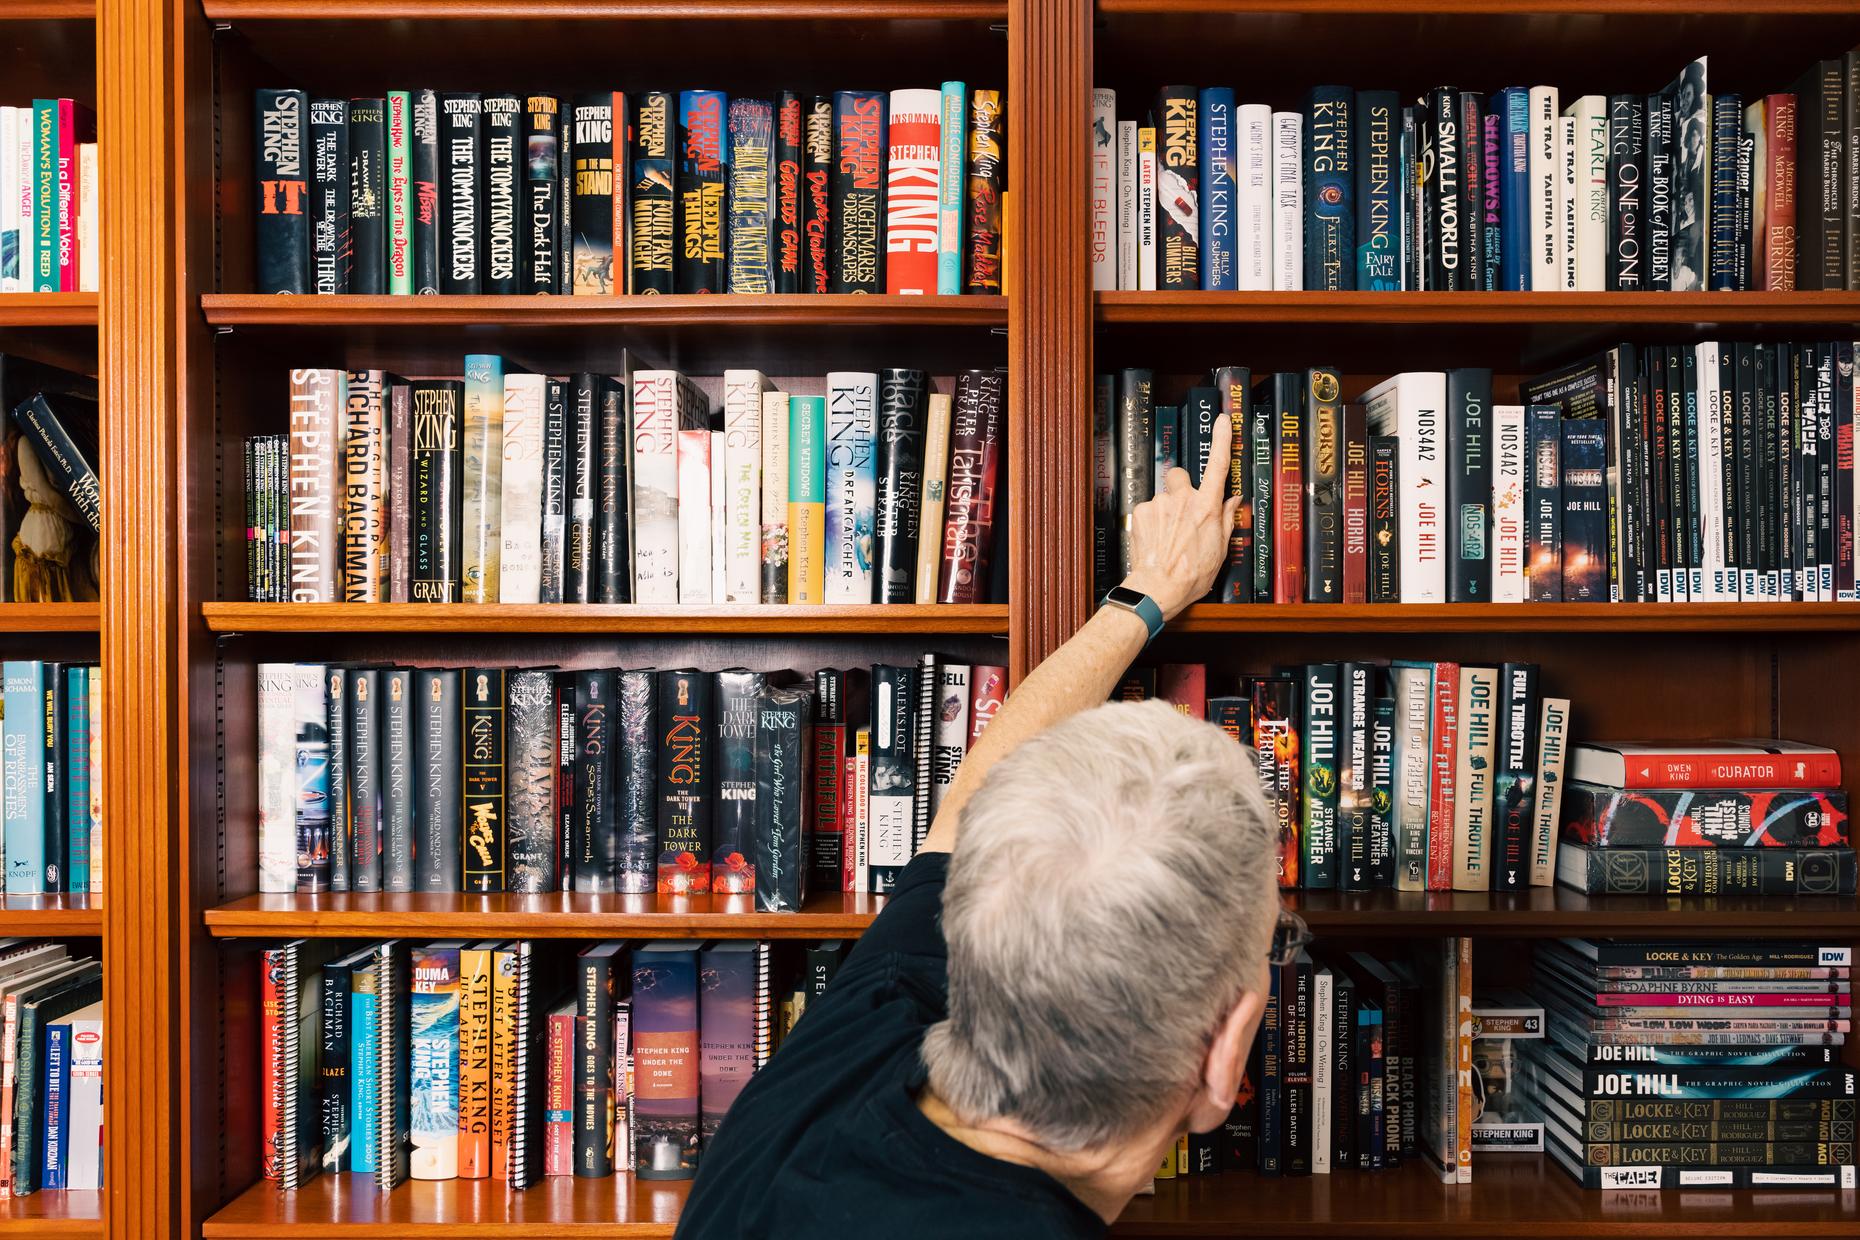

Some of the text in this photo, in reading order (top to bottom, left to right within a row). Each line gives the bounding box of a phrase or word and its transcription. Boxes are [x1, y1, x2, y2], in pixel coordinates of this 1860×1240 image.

[444, 100, 482, 115] STEPHEN
[453, 114, 473, 129] KING
[576, 107, 612, 122] STEPHEN
[891, 113, 940, 125] INSOMNIA
[1614, 102, 1629, 156] KING
[1633, 102, 1642, 156] TABITHA
[264, 111, 283, 163] KING
[275, 96, 301, 176] STEPHEN
[576, 122, 612, 144] KING
[841, 116, 857, 174] KING
[854, 98, 880, 190] STEPHEN
[890, 147, 939, 162] STEPHEN
[1166, 99, 1186, 168] KING
[1186, 99, 1197, 167] STEPHEN
[40, 109, 53, 277] WOMAN'S EVOLUTION REED
[260, 181, 308, 215] IT
[576, 172, 613, 195] STAND
[1123, 126, 1132, 229] Stephen King On Writing
[1371, 107, 1389, 250] STEPHEN KING
[1439, 96, 1459, 269] KING SMALL WORLD
[1544, 96, 1554, 265] THE TRAP TABITHA KING
[59, 158, 70, 267] In a Different Voice
[452, 137, 475, 280] THE TOMMYKNOCKERS
[683, 189, 703, 259] THINGS
[702, 183, 725, 264] NEEDFUL
[888, 167, 939, 254] KING
[1143, 159, 1151, 247] LATER STEPHEN KING
[1652, 154, 1669, 282] The BOOK of REUBEN
[534, 184, 552, 284] The Dark Half
[1619, 164, 1640, 288] ONE ON ONE
[1166, 236, 1182, 284] SUMMERS
[1183, 246, 1197, 275] BILLY
[1367, 252, 1395, 268] FAIRY
[1367, 265, 1393, 277] TALE
[1671, 358, 1677, 368] 2
[414, 390, 457, 416] STEPHEN
[1671, 392, 1680, 426] LOCKE
[414, 416, 457, 459] KING
[831, 388, 855, 467] KING
[855, 386, 872, 470] STEPHEN
[1418, 409, 1435, 462] NOS4A2
[1466, 392, 1482, 476] JOE HILL
[801, 404, 811, 497] SECRET WINDOWS
[1672, 439, 1680, 462] KEY
[348, 371, 370, 603] RICHARD BACHMAN
[1348, 441, 1365, 555] JOE HILL HORNS
[1567, 501, 1601, 512] JOE HILL
[844, 472, 853, 579] DREAMCATCHER
[1419, 503, 1437, 563] JOE HILL
[420, 535, 428, 570] GLASS
[414, 582, 455, 602] GRANT
[939, 673, 966, 687] CELL
[1311, 676, 1333, 763] JOE HILL
[1469, 676, 1491, 759] JOE HILL
[1510, 671, 1527, 771] FULL THROTTLE
[936, 746, 950, 785] KING
[1668, 764, 1692, 773] OWEN
[1670, 773, 1690, 781] KING
[1718, 766, 1774, 779] CURATOR
[668, 829, 698, 839] DARK
[672, 816, 693, 826] THE
[1311, 799, 1324, 866] WEATHER
[1325, 808, 1334, 854] STRANGE
[1468, 774, 1485, 872] FULL THROTTLE
[664, 842, 702, 852] TOWER
[416, 968, 449, 982] DUMA
[1646, 952, 1680, 961] LOCKE
[1692, 953, 1713, 961] KEY
[1822, 952, 1845, 961] IDW
[416, 981, 435, 993] KEY
[587, 967, 597, 1016] STEPHEN
[1678, 996, 1715, 1005] DYING
[1728, 996, 1756, 1005] EASY
[586, 1019, 596, 1051] KING
[1288, 1005, 1296, 1063] OF THE YEAR
[1298, 1021, 1306, 1064] HORROR
[1486, 1019, 1520, 1027] STEPHEN
[1525, 1019, 1539, 1030] 43
[472, 974, 488, 1136] STEPHEN KING
[1594, 1046, 1659, 1061] JOE HILL
[587, 1088, 595, 1101] THE
[588, 1076, 595, 1085] TO
[1594, 1074, 1683, 1095] JOE HILL
[586, 1103, 595, 1131] MOVIES
[1472, 1130, 1505, 1139] STEPHEN
[1507, 1130, 1533, 1139] KING
